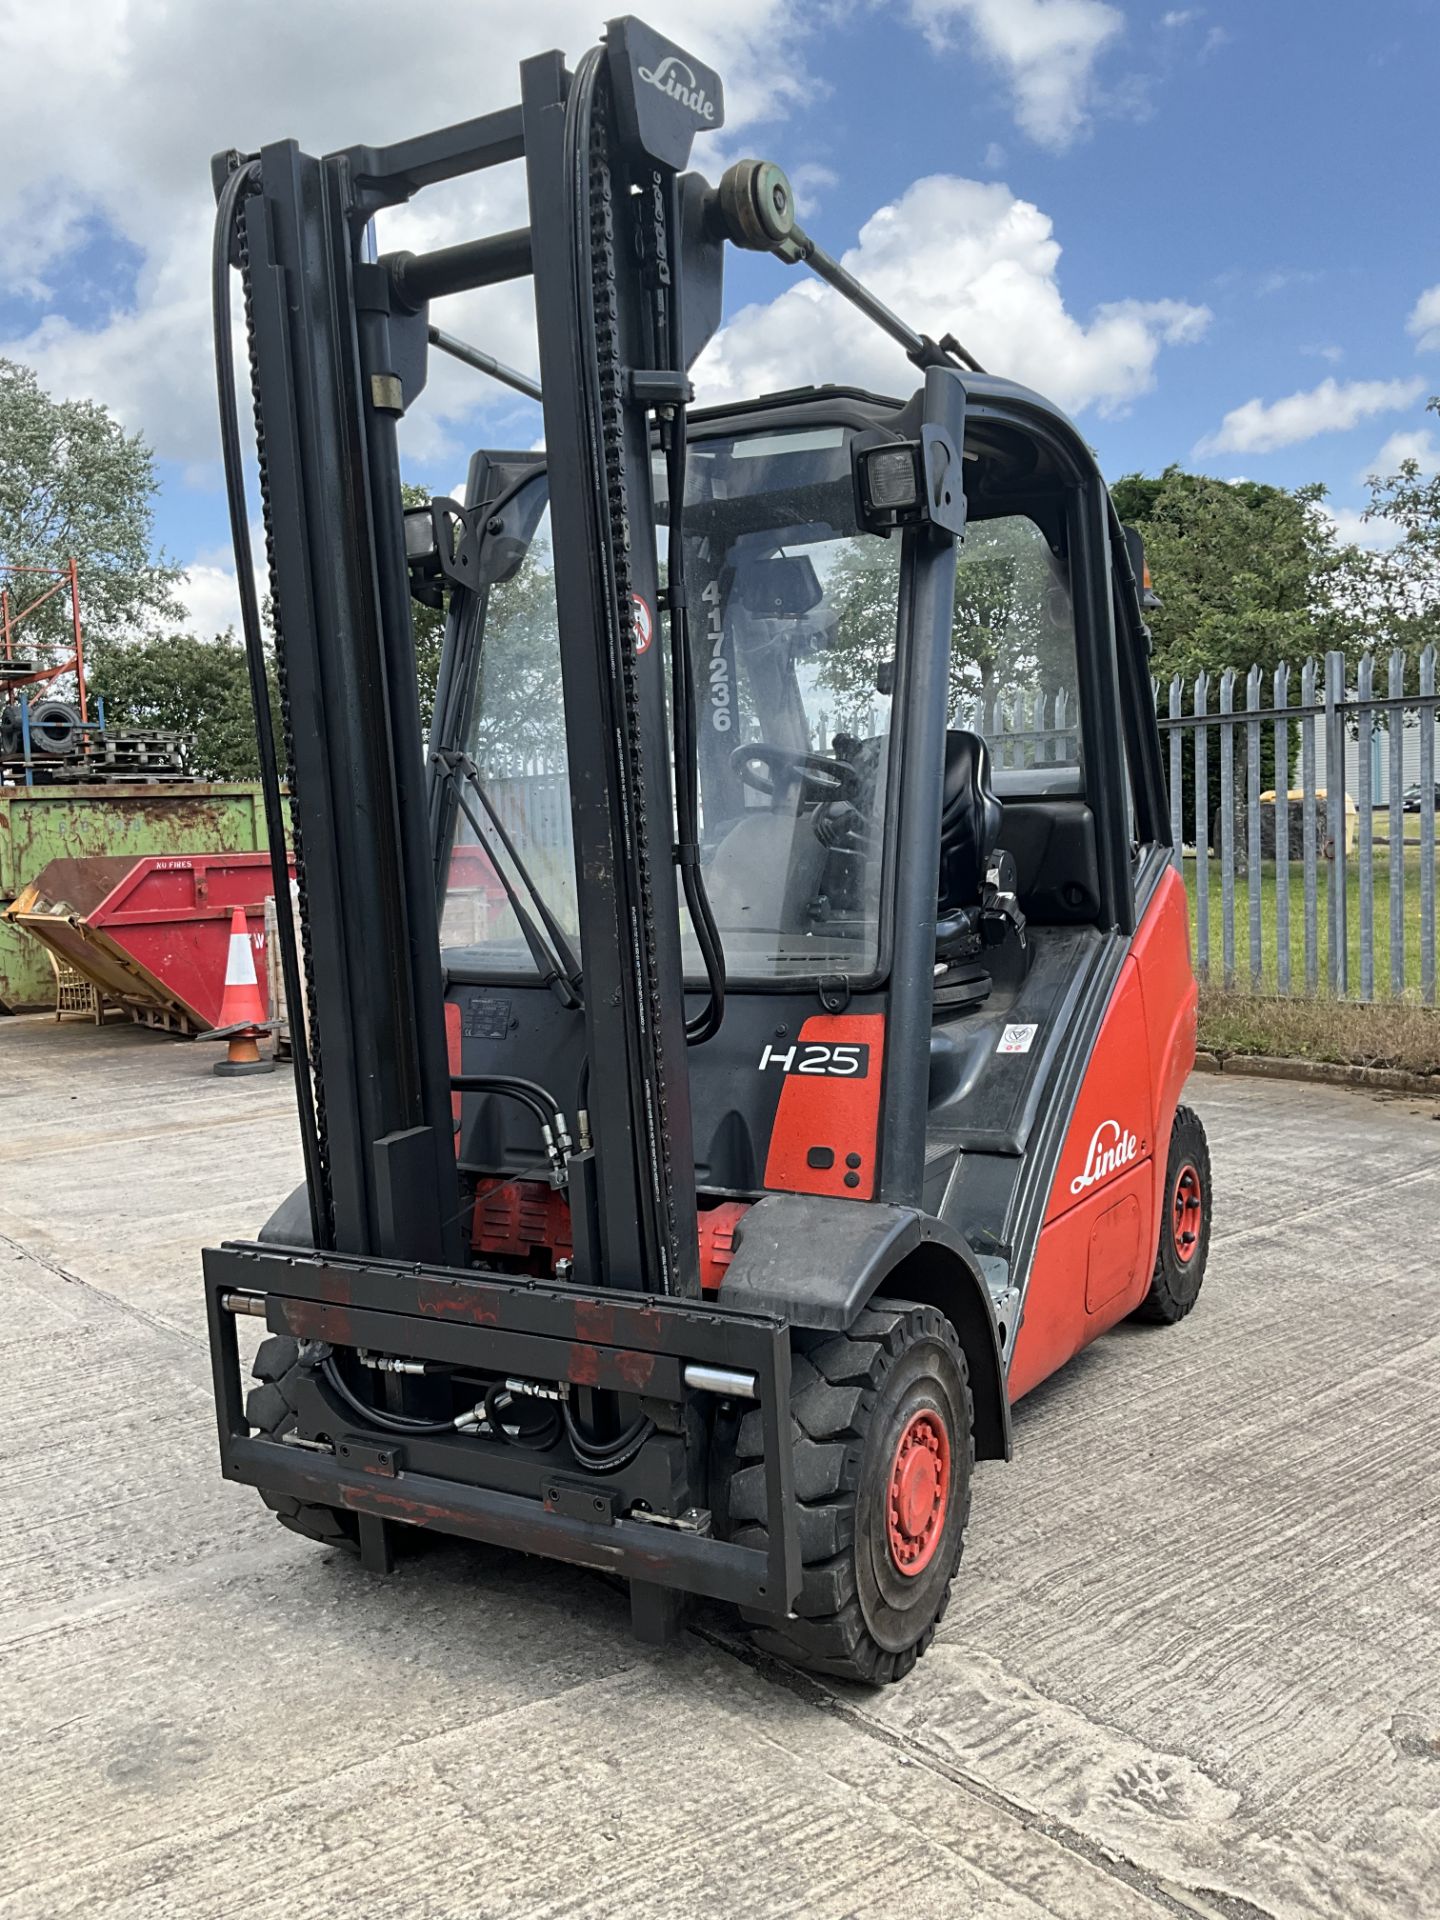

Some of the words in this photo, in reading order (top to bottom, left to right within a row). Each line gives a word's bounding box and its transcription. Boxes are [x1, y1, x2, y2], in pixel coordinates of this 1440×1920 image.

[638, 57, 714, 120] Linde
[702, 581, 731, 731] 417236
[169, 861, 192, 869] FIRES
[1070, 1120, 1137, 1194] Linde
